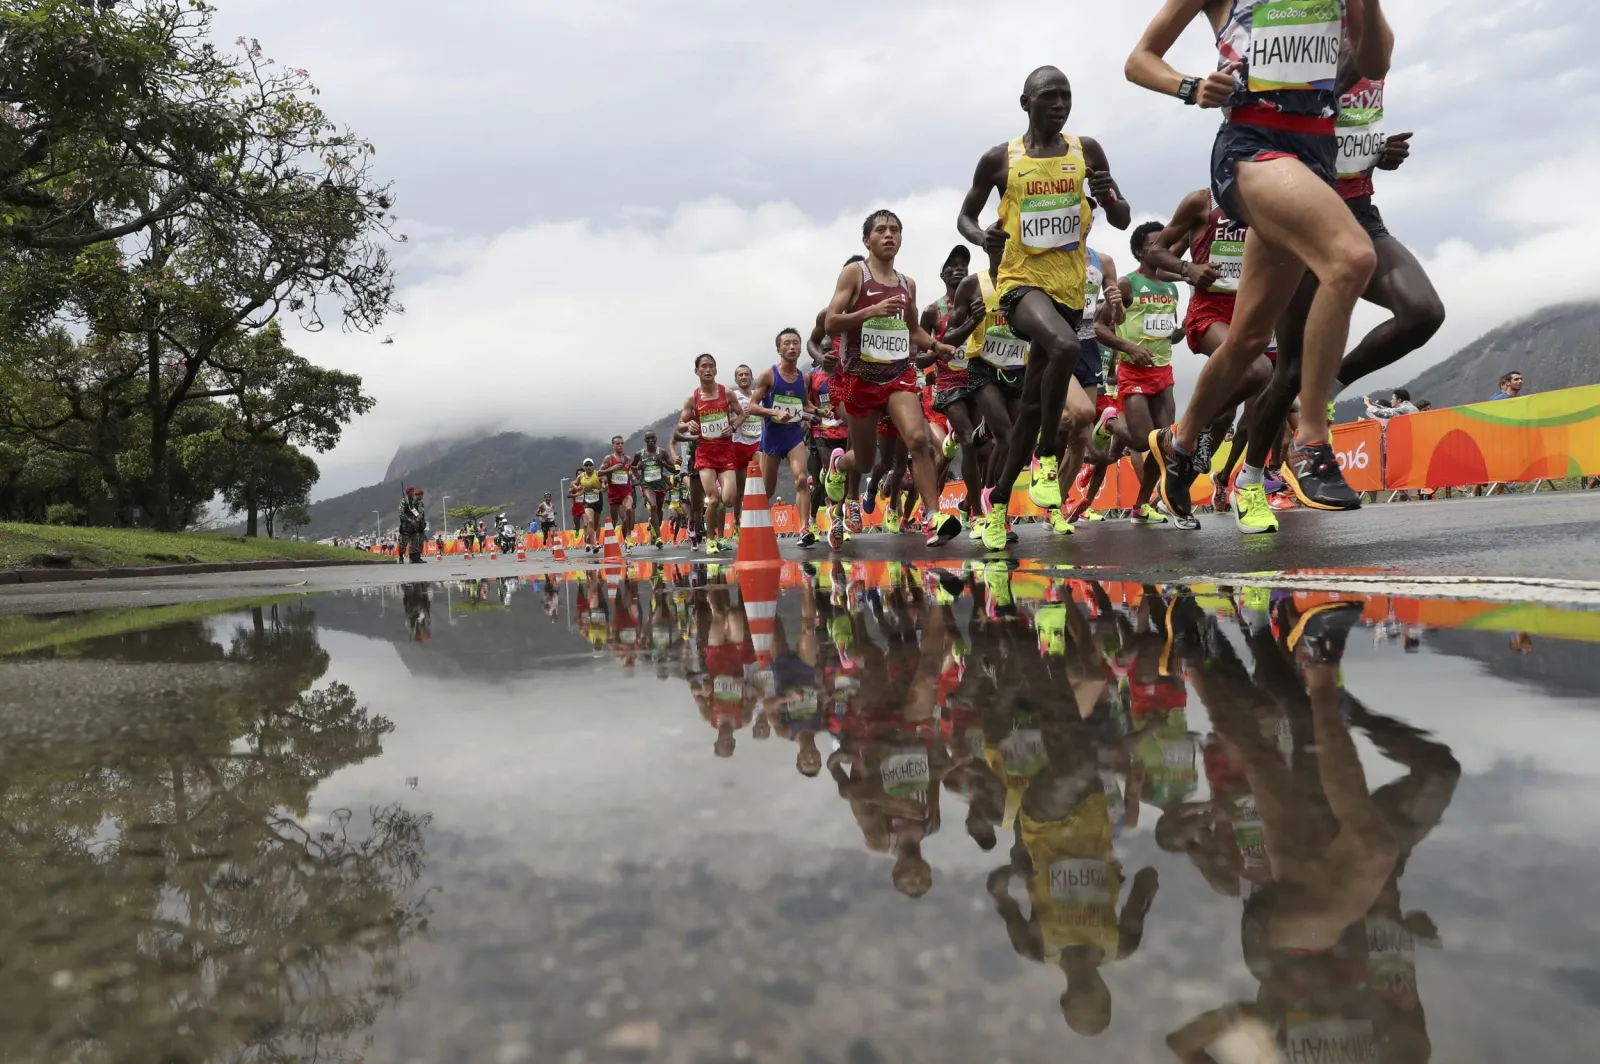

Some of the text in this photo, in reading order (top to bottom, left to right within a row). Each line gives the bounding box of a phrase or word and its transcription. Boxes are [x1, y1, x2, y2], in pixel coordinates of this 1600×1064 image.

[1267, 7, 1307, 20] Rio2016
[1252, 35, 1339, 67] HAWKINS
[1026, 178, 1075, 196] UGANDA
[1029, 199, 1056, 208] Rio2016
[1022, 215, 1080, 238] KIPROP
[1145, 319, 1175, 331] LILESA
[862, 333, 908, 353] PACHECO
[982, 341, 1024, 359] MUTAI
[1333, 441, 1369, 471] 016
